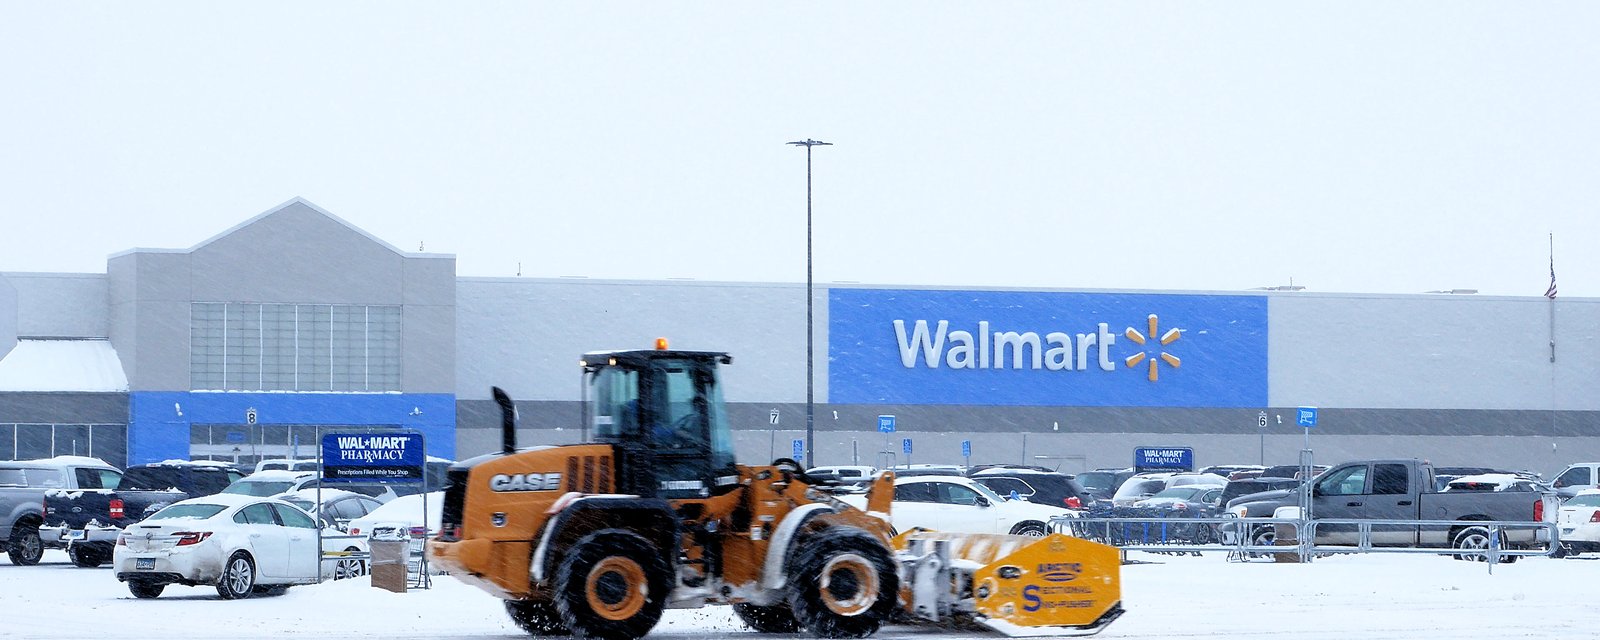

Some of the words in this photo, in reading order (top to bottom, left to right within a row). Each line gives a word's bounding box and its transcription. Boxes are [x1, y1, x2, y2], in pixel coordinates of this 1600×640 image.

[893, 319, 1115, 371] Walmart
[341, 450, 405, 463] PHARMACY
[490, 473, 562, 491] CASE
